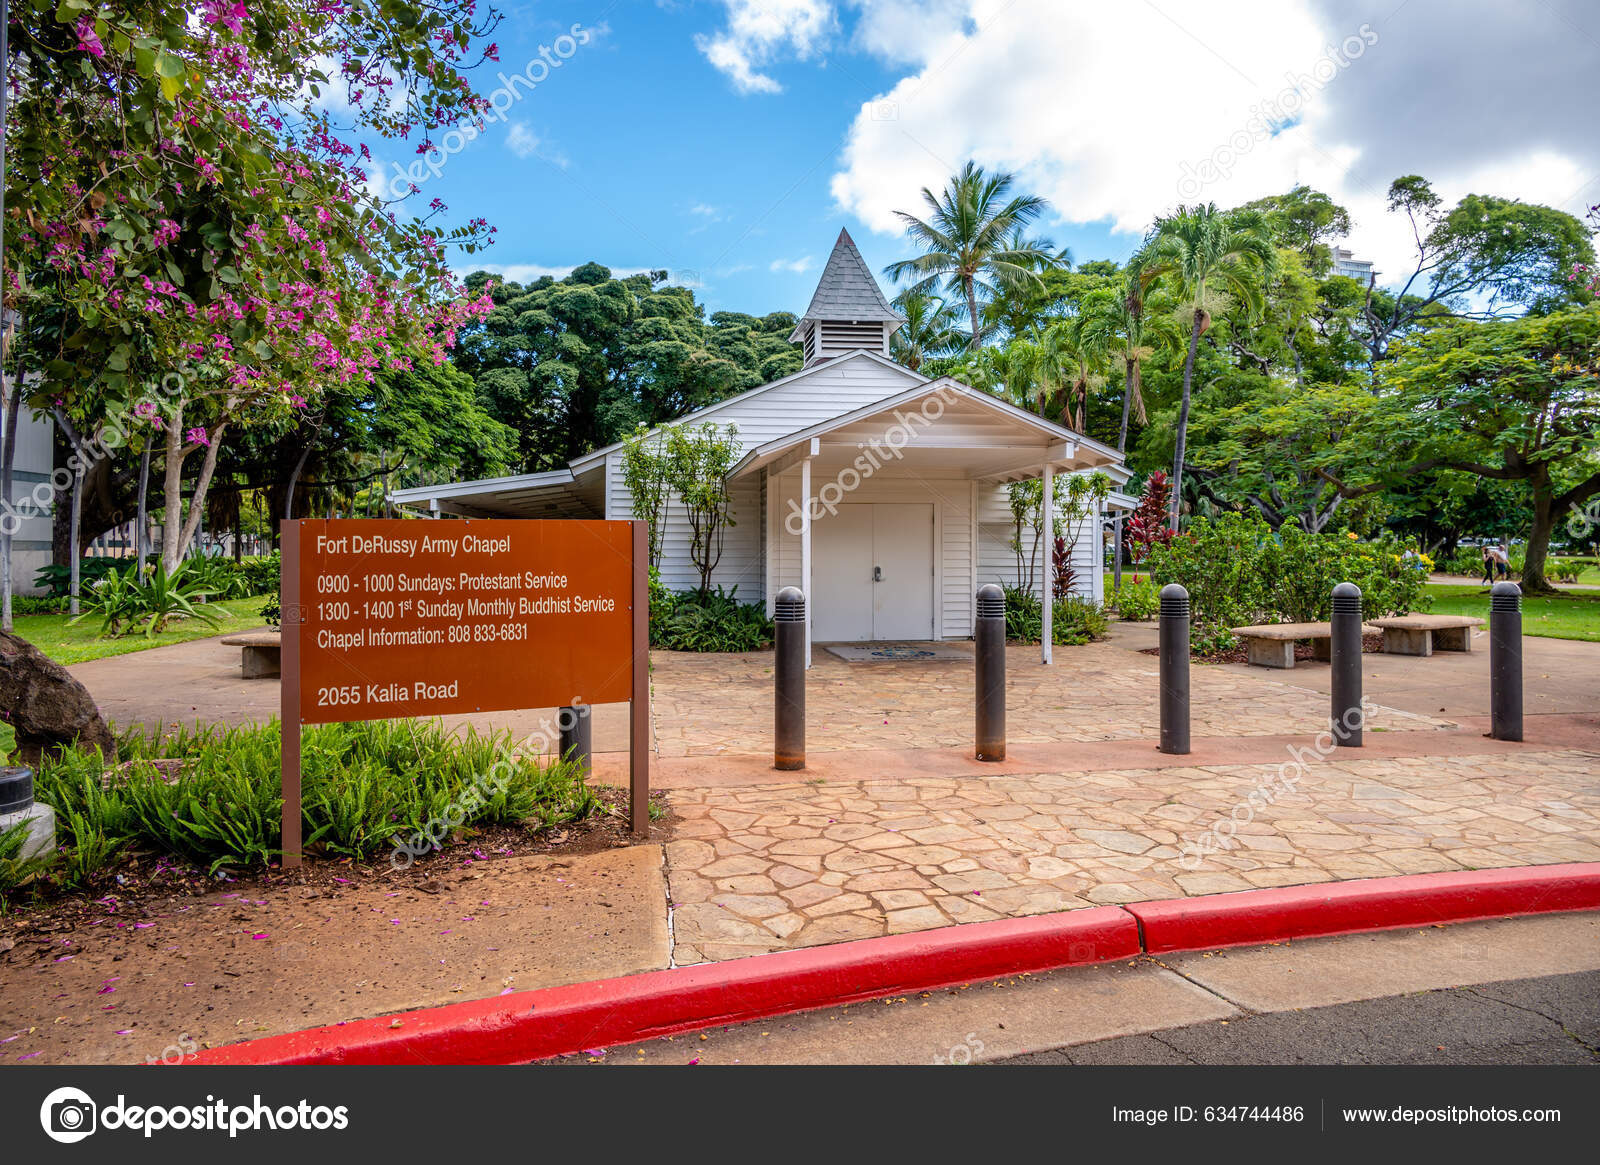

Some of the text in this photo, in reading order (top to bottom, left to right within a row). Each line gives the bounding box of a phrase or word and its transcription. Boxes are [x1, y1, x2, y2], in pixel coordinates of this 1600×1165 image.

[317, 534, 511, 558] Fort DeRussy Army Chapel
[317, 574, 350, 594] 0900
[363, 573, 395, 592] 1000
[398, 573, 456, 595] Sundays:
[459, 572, 522, 591] Protestant
[524, 571, 568, 590] Service
[318, 602, 350, 621] 1300
[363, 601, 395, 619] 1400
[398, 599, 413, 619] 1st
[417, 599, 464, 621] Sunday
[467, 597, 516, 620] Monthly
[519, 596, 571, 615] Buddhist
[573, 595, 615, 613] Service
[317, 623, 528, 652] Chapel Information: 808 833-6831
[317, 680, 459, 707] 2055 Kalia Road
